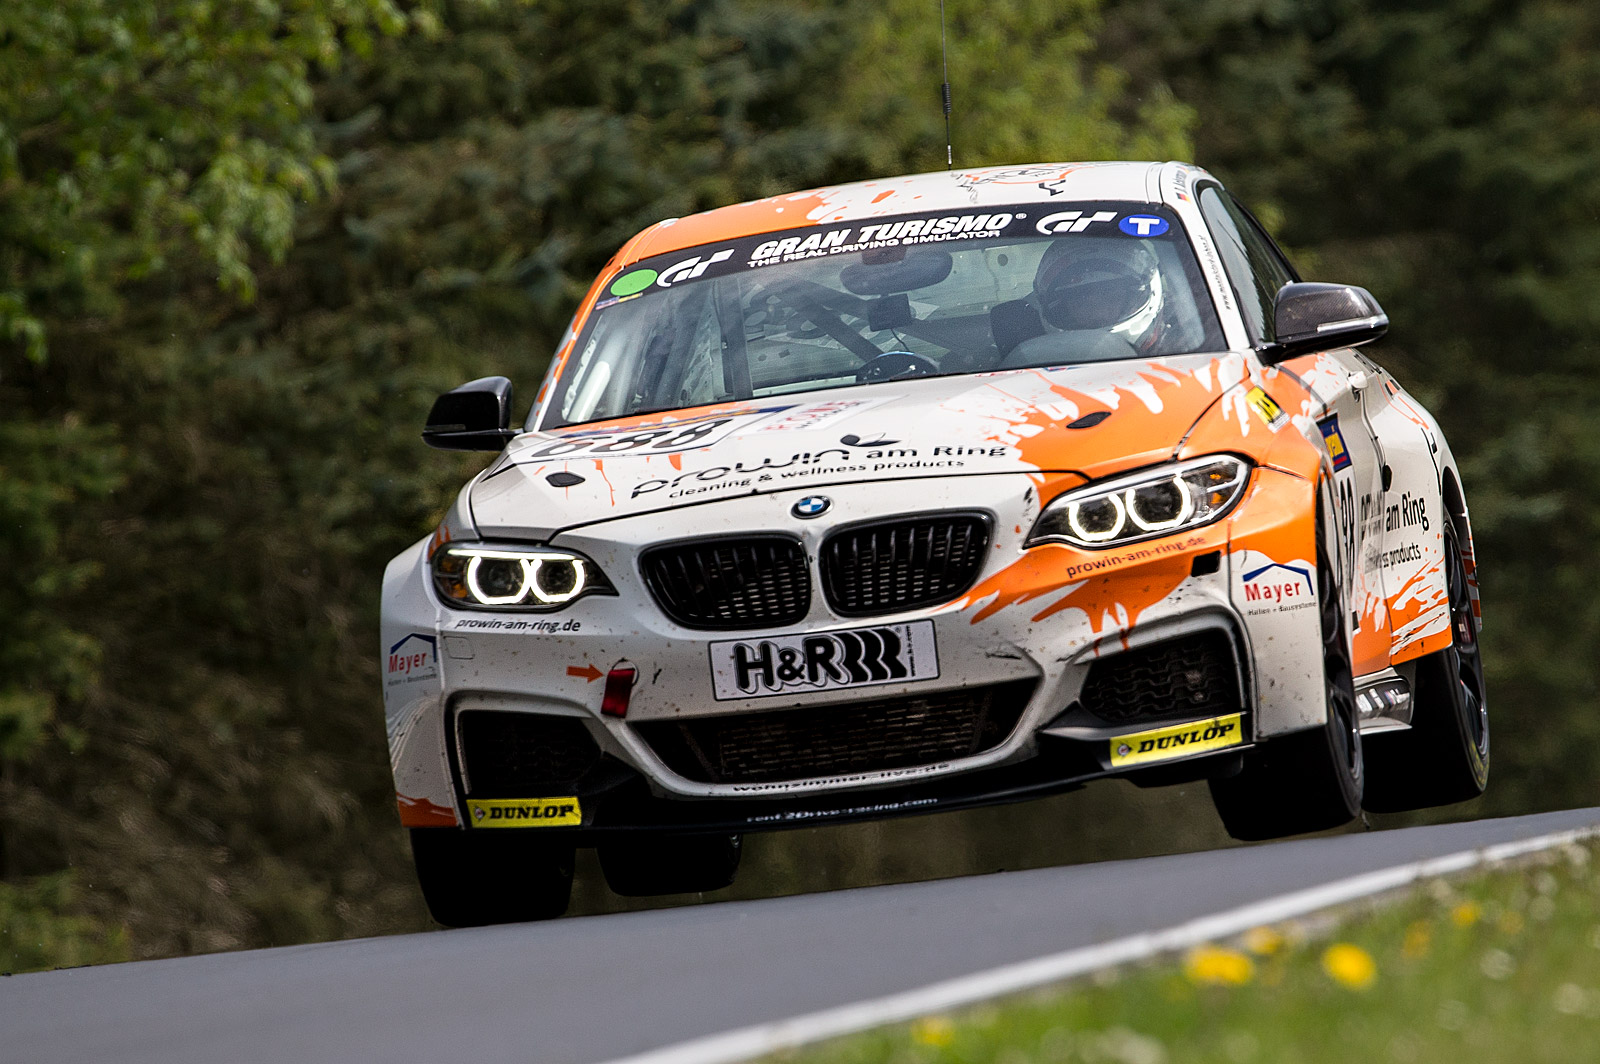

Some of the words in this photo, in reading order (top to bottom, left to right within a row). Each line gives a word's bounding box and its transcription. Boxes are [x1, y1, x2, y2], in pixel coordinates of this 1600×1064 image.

[747, 256, 781, 268] THE
[783, 249, 828, 263] REAL
[830, 238, 899, 256] DRIVING
[902, 230, 1001, 245] SIMULATOR
[751, 229, 851, 261] GRAN
[631, 449, 850, 499] prowin
[866, 449, 918, 459] am
[933, 446, 1009, 458] Ring
[669, 478, 753, 498] cleaning
[758, 474, 773, 482] &
[781, 464, 867, 479] wellness
[874, 460, 965, 472] products
[1386, 502, 1400, 532] am
[1402, 491, 1430, 532] Ring
[1066, 536, 1207, 579] prowin-am-ring.de
[1389, 541, 1422, 569] products
[1245, 581, 1302, 603] Mayer
[455, 619, 581, 634] prowin-am-ring.de
[388, 652, 427, 676] Mayer
[1137, 723, 1235, 753] DUNLOP
[490, 805, 574, 819] DUNLOP
